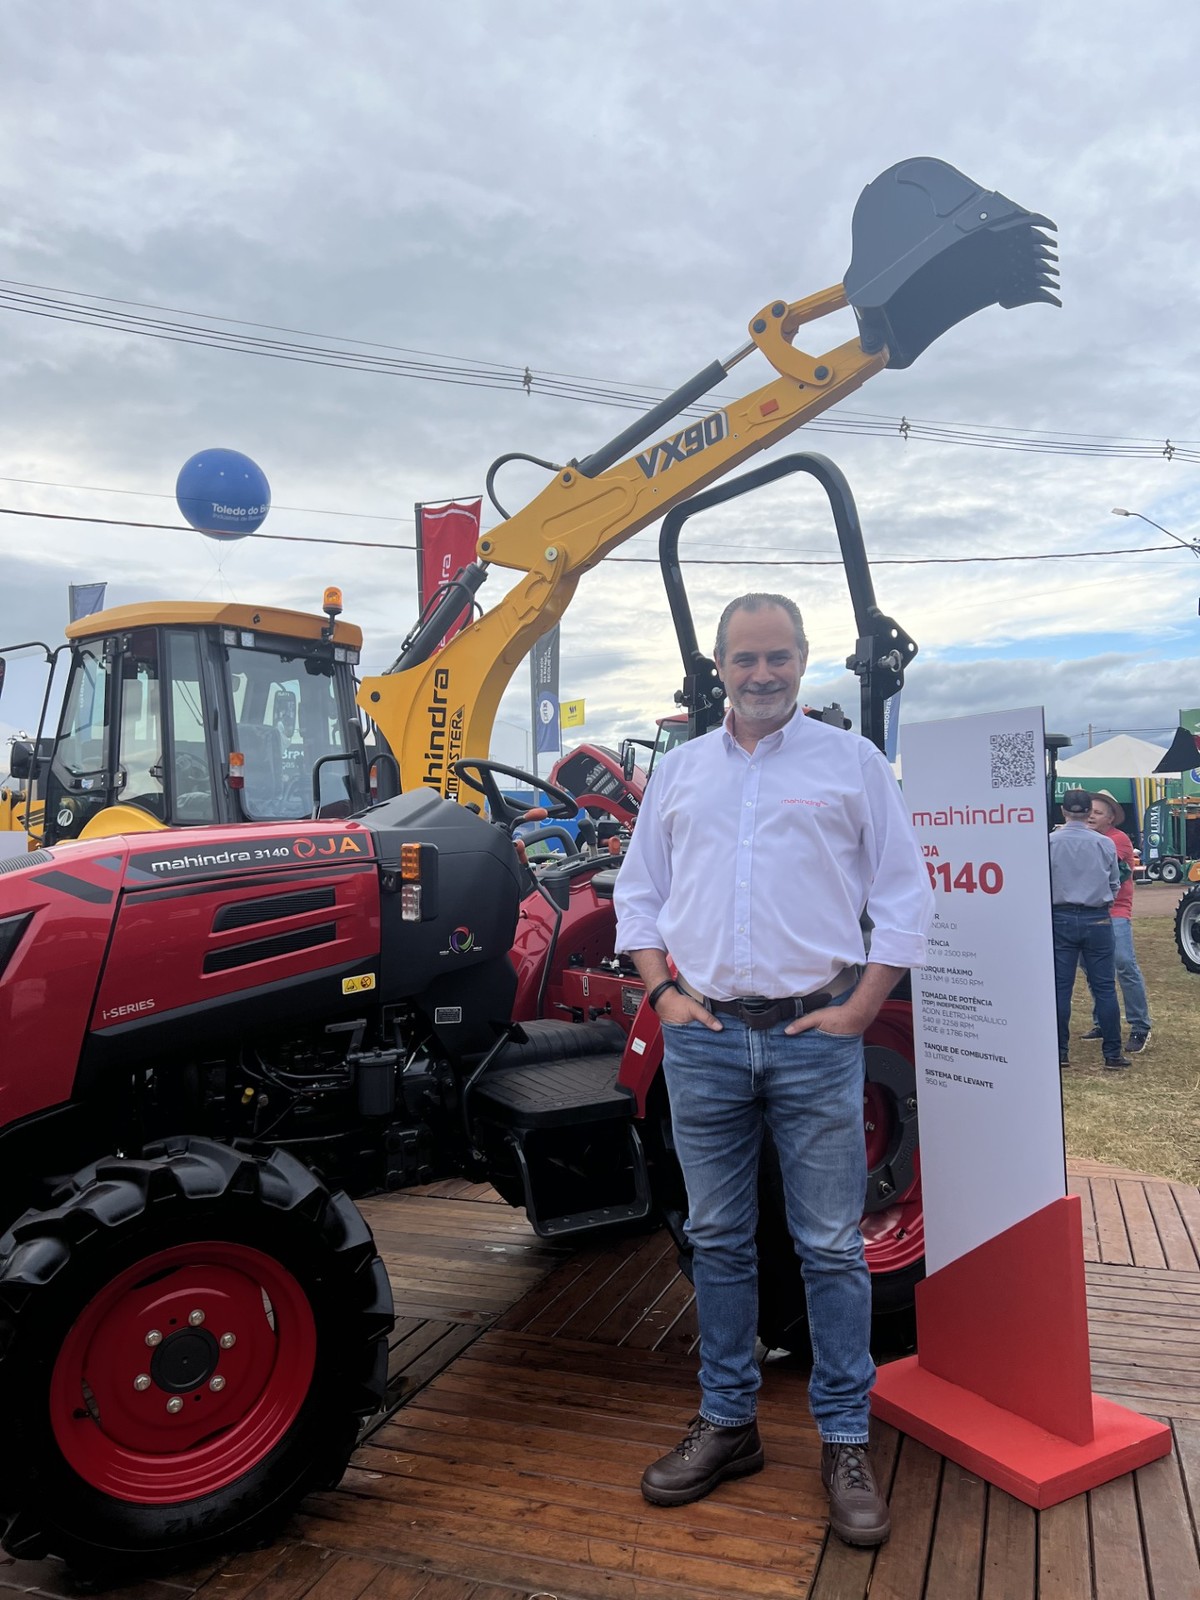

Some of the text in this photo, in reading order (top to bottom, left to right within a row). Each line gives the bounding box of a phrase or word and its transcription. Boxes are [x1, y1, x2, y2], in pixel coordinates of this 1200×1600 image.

[635, 411, 729, 479] VX90
[212, 503, 246, 516] Toledo
[248, 507, 259, 515] do
[423, 668, 449, 794] hindra
[446, 717, 463, 802] HMASTER
[1055, 782, 1086, 794] UMA
[912, 803, 1034, 826] mahindra
[1150, 806, 1161, 834] LUMA
[921, 845, 940, 857] JA
[151, 850, 251, 873] mahindra
[254, 846, 290, 860] 3140
[931, 922, 949, 930] NDRA
[927, 937, 950, 948] TÊNCIA
[944, 949, 961, 957] 2500
[961, 951, 977, 959] RPM
[946, 967, 973, 977] MÁXIMO
[968, 978, 984, 987] RPM
[921, 990, 948, 1001] TOMADA
[958, 995, 993, 1007] POTÊNCIA
[102, 998, 156, 1020] i-SERIES
[936, 1001, 977, 1012] INDEPENDENTE
[922, 1015, 935, 1024] 540
[942, 1019, 959, 1028] 2258
[959, 1021, 975, 1030] RPM
[923, 1024, 939, 1034] 540E
[946, 1028, 963, 1037] 1786
[963, 1031, 979, 1039] RPM
[924, 1042, 1008, 1064] TANQUE DE COMBUSTÍVEL
[932, 1052, 954, 1063] LITROS
[925, 1068, 994, 1089] SISTEMA DE LEVANTE
[925, 1077, 948, 1088] 950 KG
